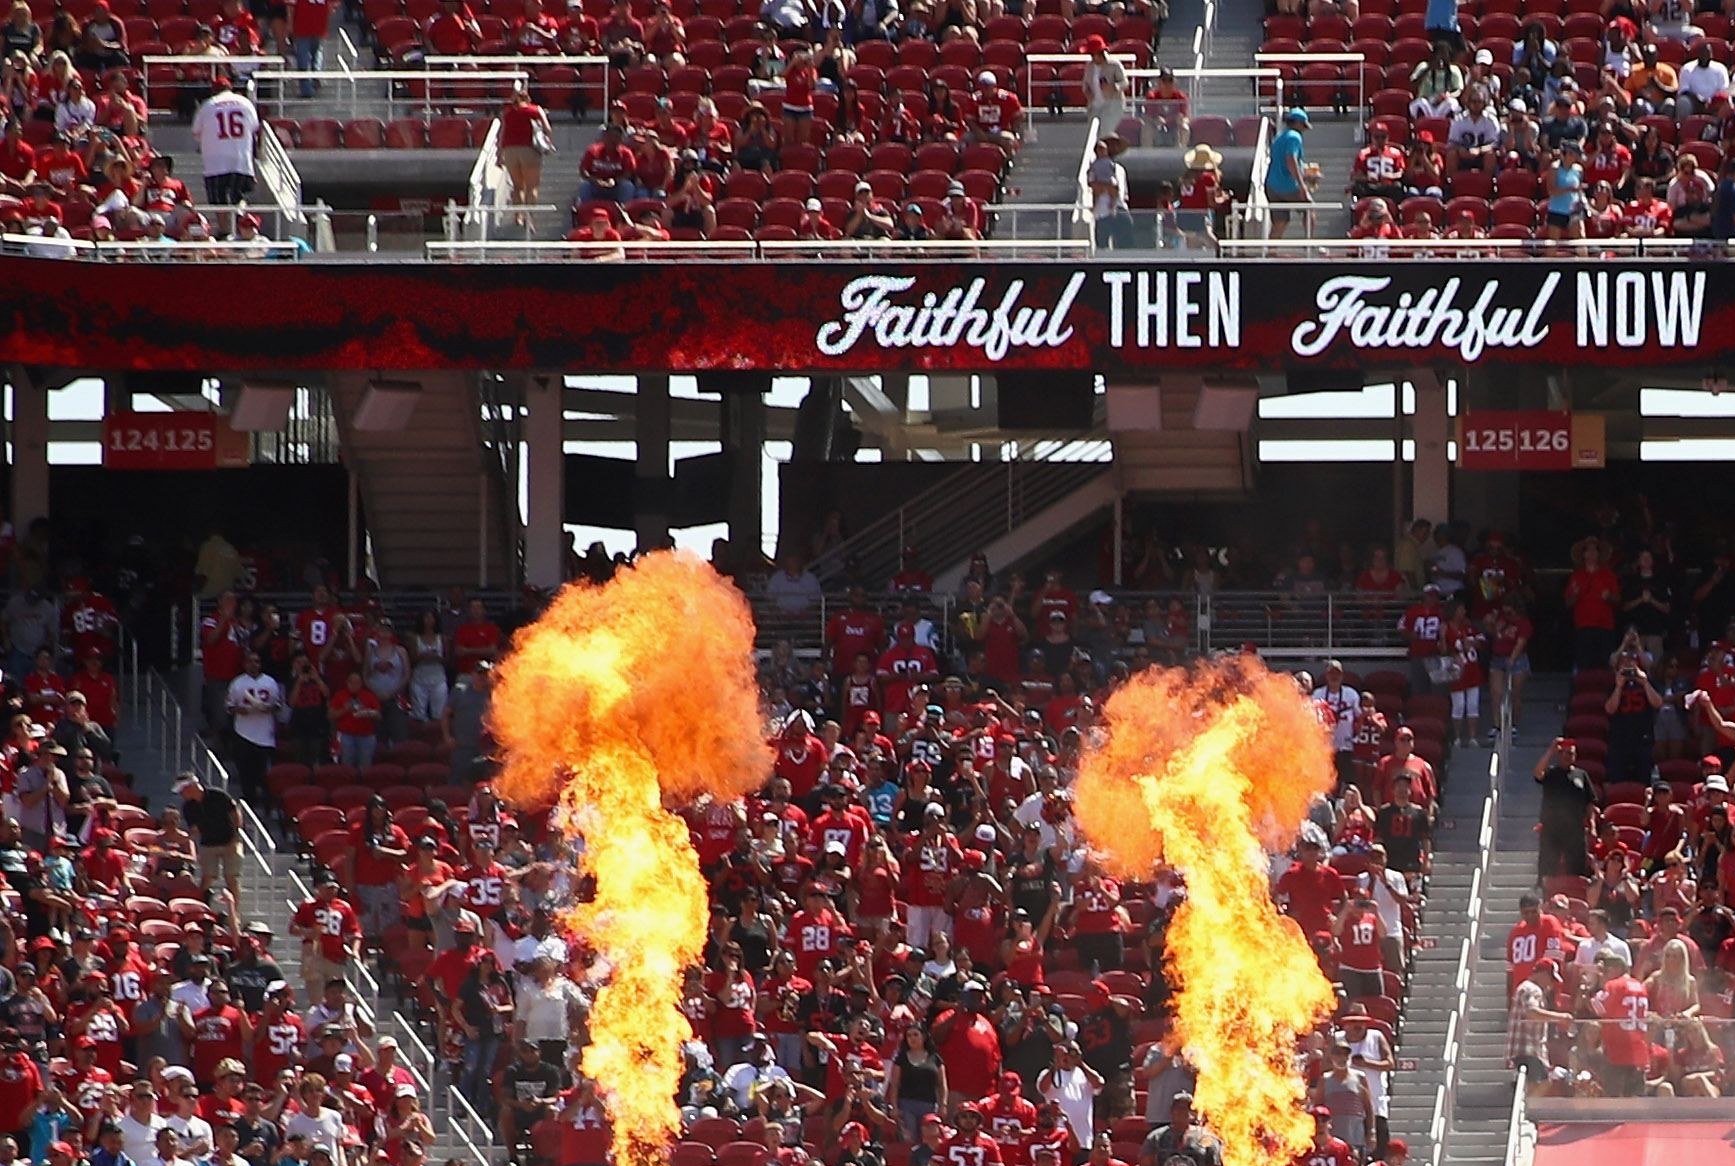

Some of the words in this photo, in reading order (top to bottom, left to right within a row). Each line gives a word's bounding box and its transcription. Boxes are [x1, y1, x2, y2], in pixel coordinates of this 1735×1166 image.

[217, 112, 243, 138] 16
[1367, 158, 1393, 177] 56
[817, 271, 1086, 361] Faithful
[1102, 271, 1240, 348] THEN
[1291, 272, 1561, 362] Faithful
[1577, 271, 1706, 347] NOW
[110, 428, 160, 451] 124
[163, 428, 213, 451] 125
[1465, 429, 1514, 451] 125
[1519, 429, 1569, 451] 126
[311, 621, 326, 644] 8
[469, 880, 500, 904] 35
[802, 927, 831, 953] 28
[1513, 935, 1536, 963] 80
[112, 973, 141, 999] 16
[269, 1027, 298, 1054] 52
